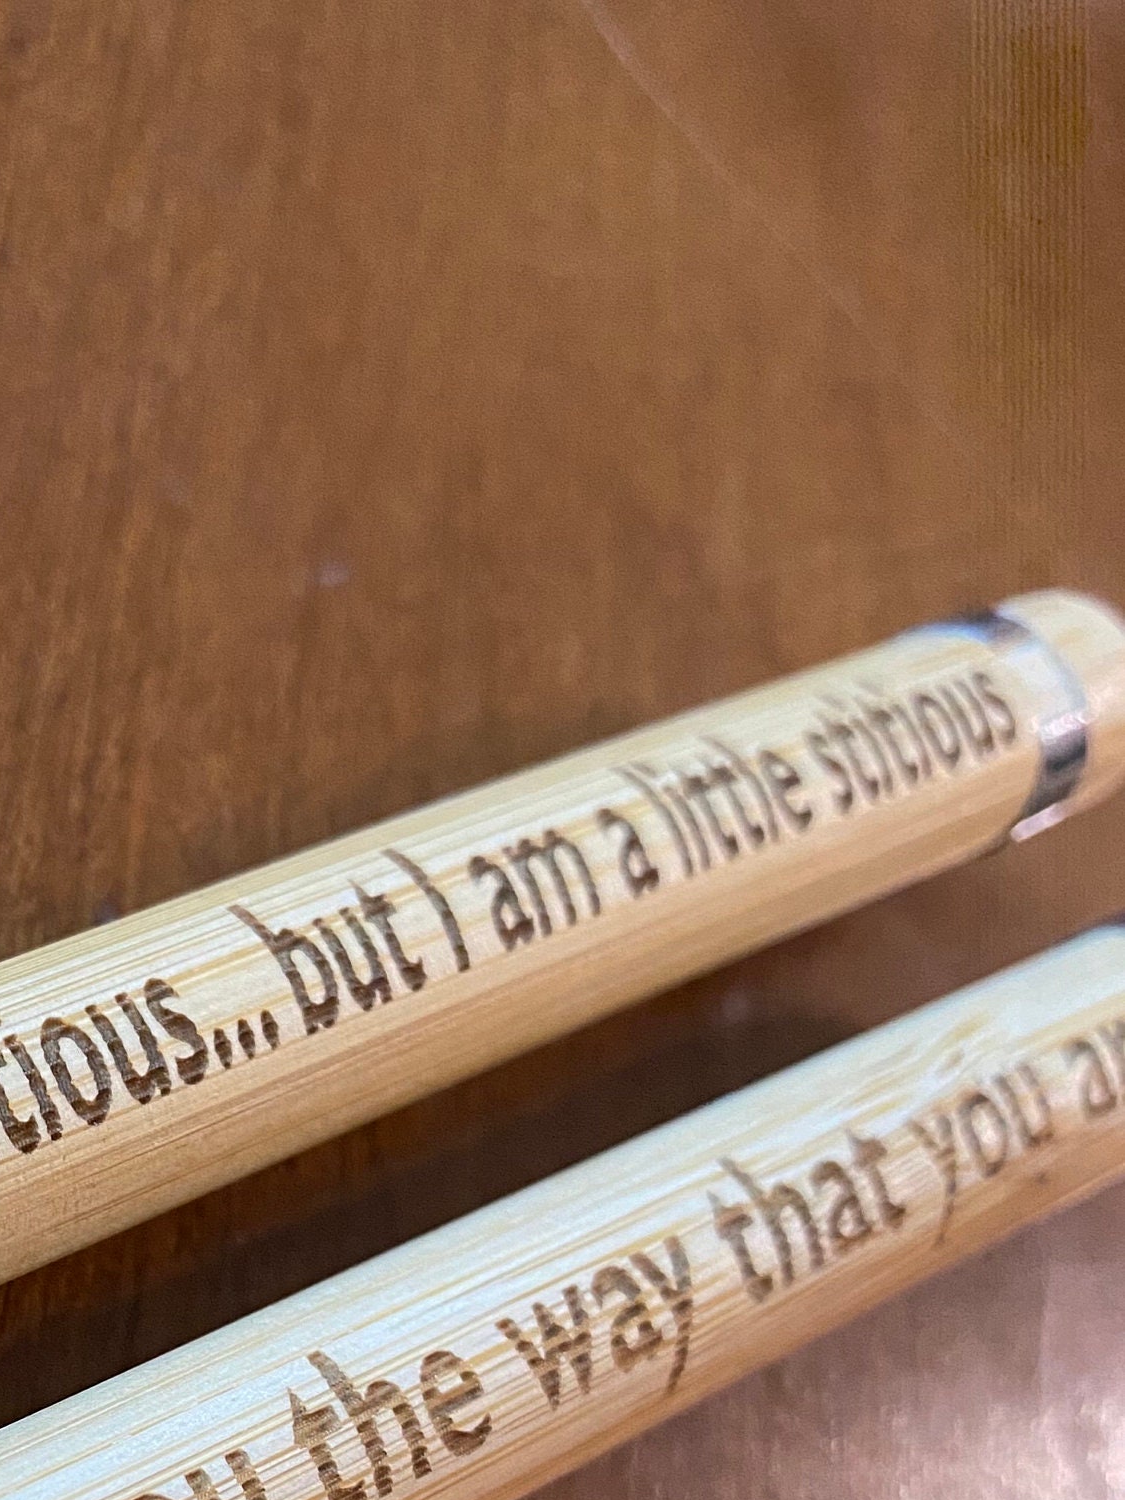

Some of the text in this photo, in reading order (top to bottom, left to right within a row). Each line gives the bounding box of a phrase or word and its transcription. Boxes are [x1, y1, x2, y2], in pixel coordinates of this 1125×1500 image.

[803, 668, 1019, 810] stitious
[596, 807, 661, 899] a
[613, 735, 815, 878] little
[390, 852, 471, 972] I
[469, 829, 602, 950] am
[495, 1234, 693, 1410] way
[706, 1129, 906, 1302] that
[908, 1062, 1055, 1246] you
